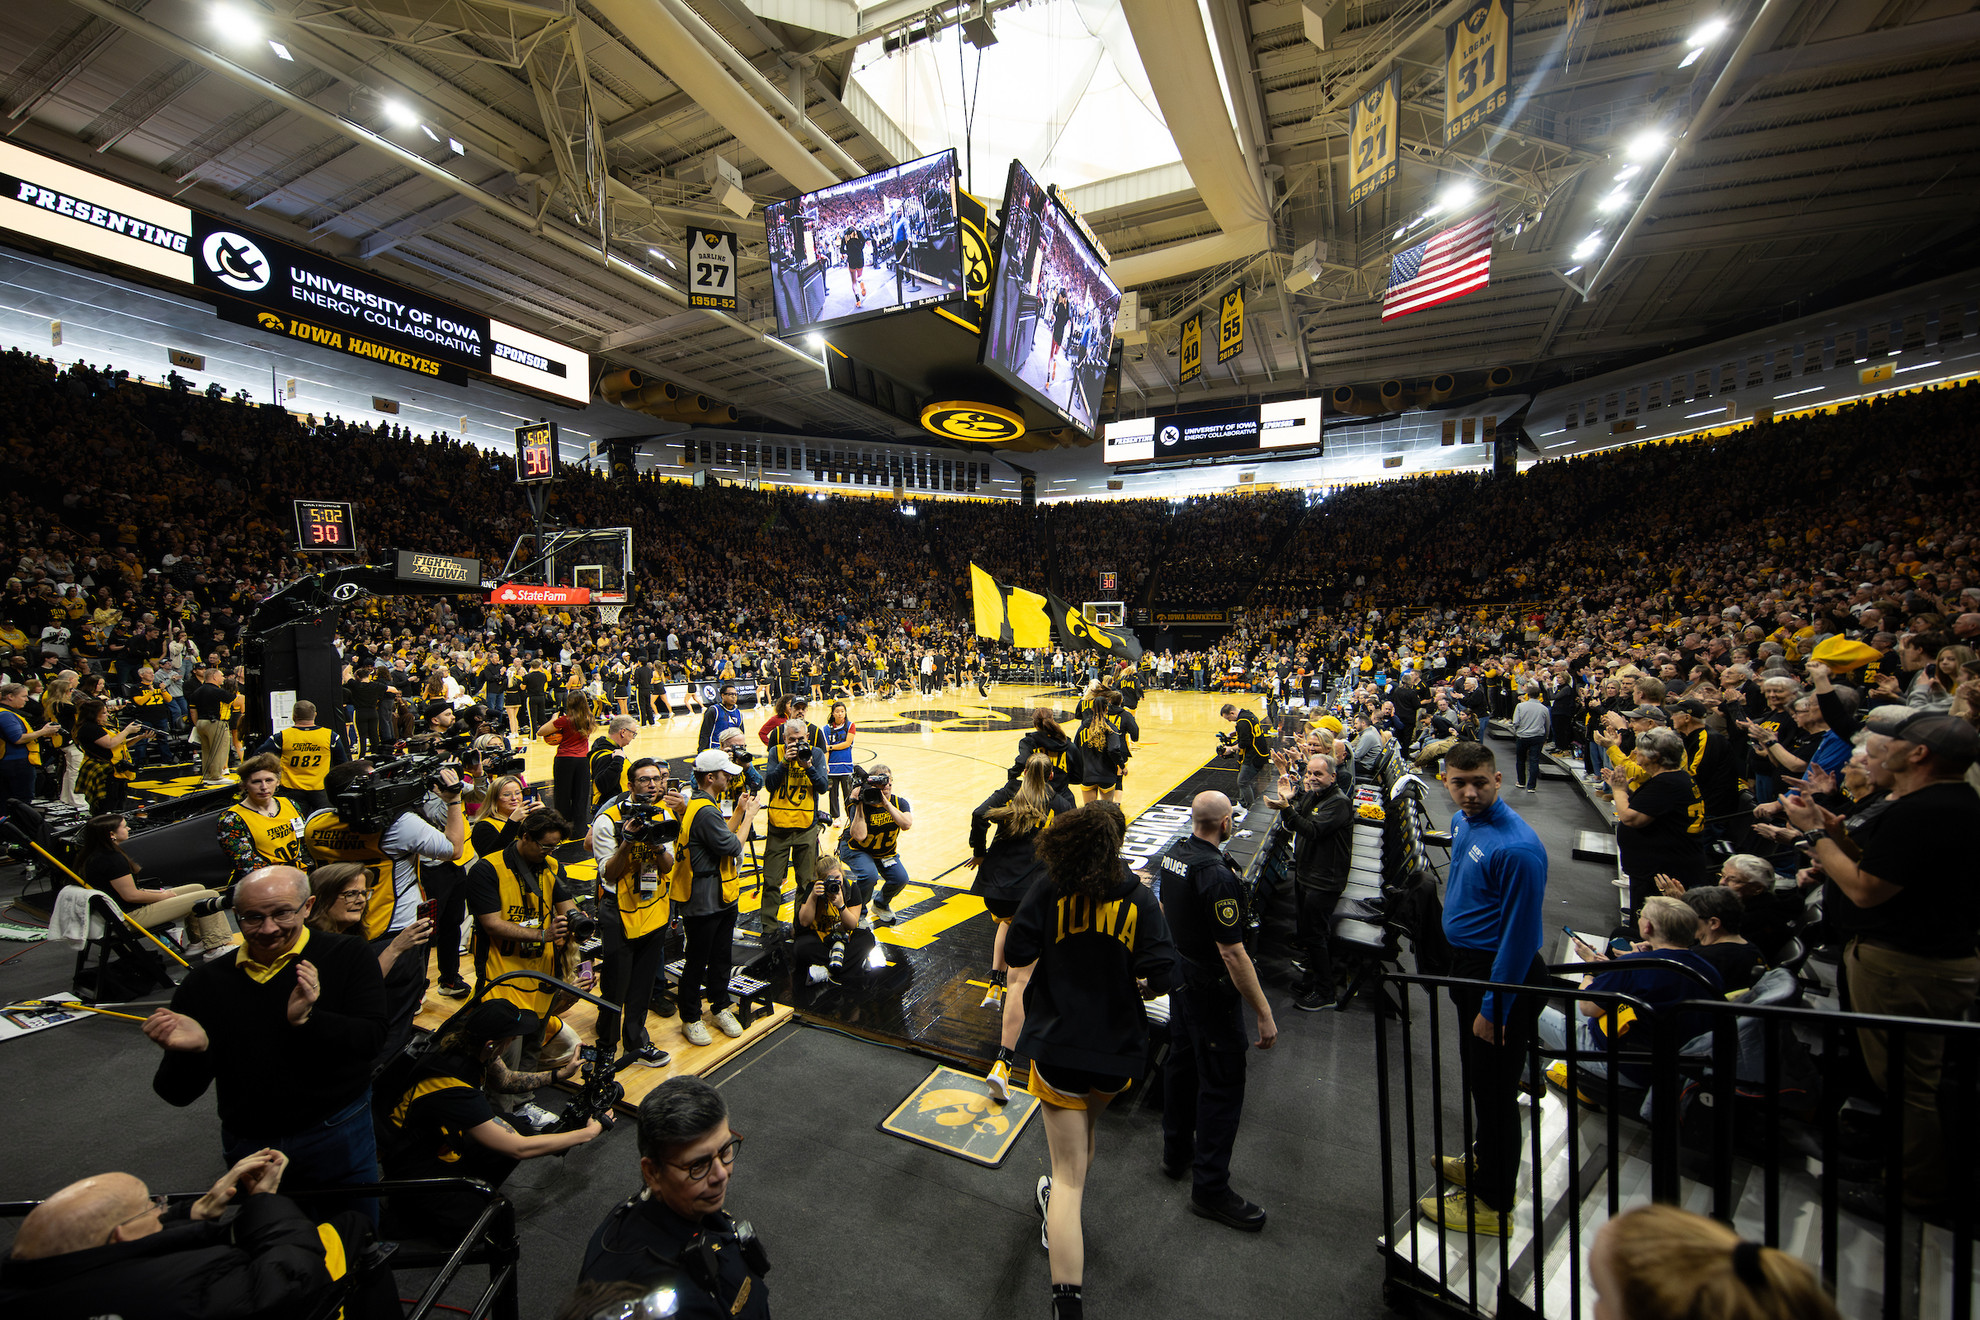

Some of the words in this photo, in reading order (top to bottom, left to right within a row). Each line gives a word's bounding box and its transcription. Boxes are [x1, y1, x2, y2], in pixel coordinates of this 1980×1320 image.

[1463, 32, 1492, 60] LOGAN
[1456, 44, 1495, 104] 31
[1365, 114, 1382, 132] CAIN
[1446, 90, 1507, 142] 1954-56
[1357, 124, 1387, 174] 21
[1350, 165, 1396, 205] 1954-56
[17, 182, 188, 253] PRESENTING
[698, 253, 726, 262] DARLING
[696, 262, 729, 288] 27
[290, 266, 405, 317] UNIVERSITY
[408, 308, 433, 325] OF
[436, 317, 481, 343] IOWA
[691, 295, 736, 309] 1950-52
[291, 285, 360, 318] ENERGY
[363, 309, 481, 357] COLLABORATIVE
[1223, 315, 1240, 342] 55
[288, 319, 343, 349] IOWA
[347, 337, 440, 376] HAWKEYES
[1184, 341, 1199, 364] 40
[179, 355, 195, 365] NN
[494, 343, 549, 371] SPONSOR
[1184, 424, 1224, 436] UNIVERSITY
[1225, 423, 1236, 431] OF
[1236, 421, 1257, 430] IOWA
[1184, 432, 1207, 441] ENERGY
[1207, 427, 1257, 439] COLLABORATIVE
[527, 430, 549, 446] 5:02
[526, 447, 548, 475] 30
[310, 508, 343, 523] 5:02
[311, 524, 339, 543] 30
[413, 554, 453, 568] FIGHT
[429, 566, 468, 581] IOWA
[1103, 579, 1114, 588] 30
[1167, 613, 1185, 621] IOWA
[1186, 613, 1222, 621] HAWKEYES
[1120, 679, 1135, 690] IOWA
[146, 694, 164, 706] 22
[290, 755, 322, 768] 082
[778, 784, 808, 800] 075
[311, 829, 349, 840] FIGHT
[328, 839, 366, 850] IOWA
[1160, 855, 1189, 878] POLICE
[1055, 892, 1138, 953] IOWA
